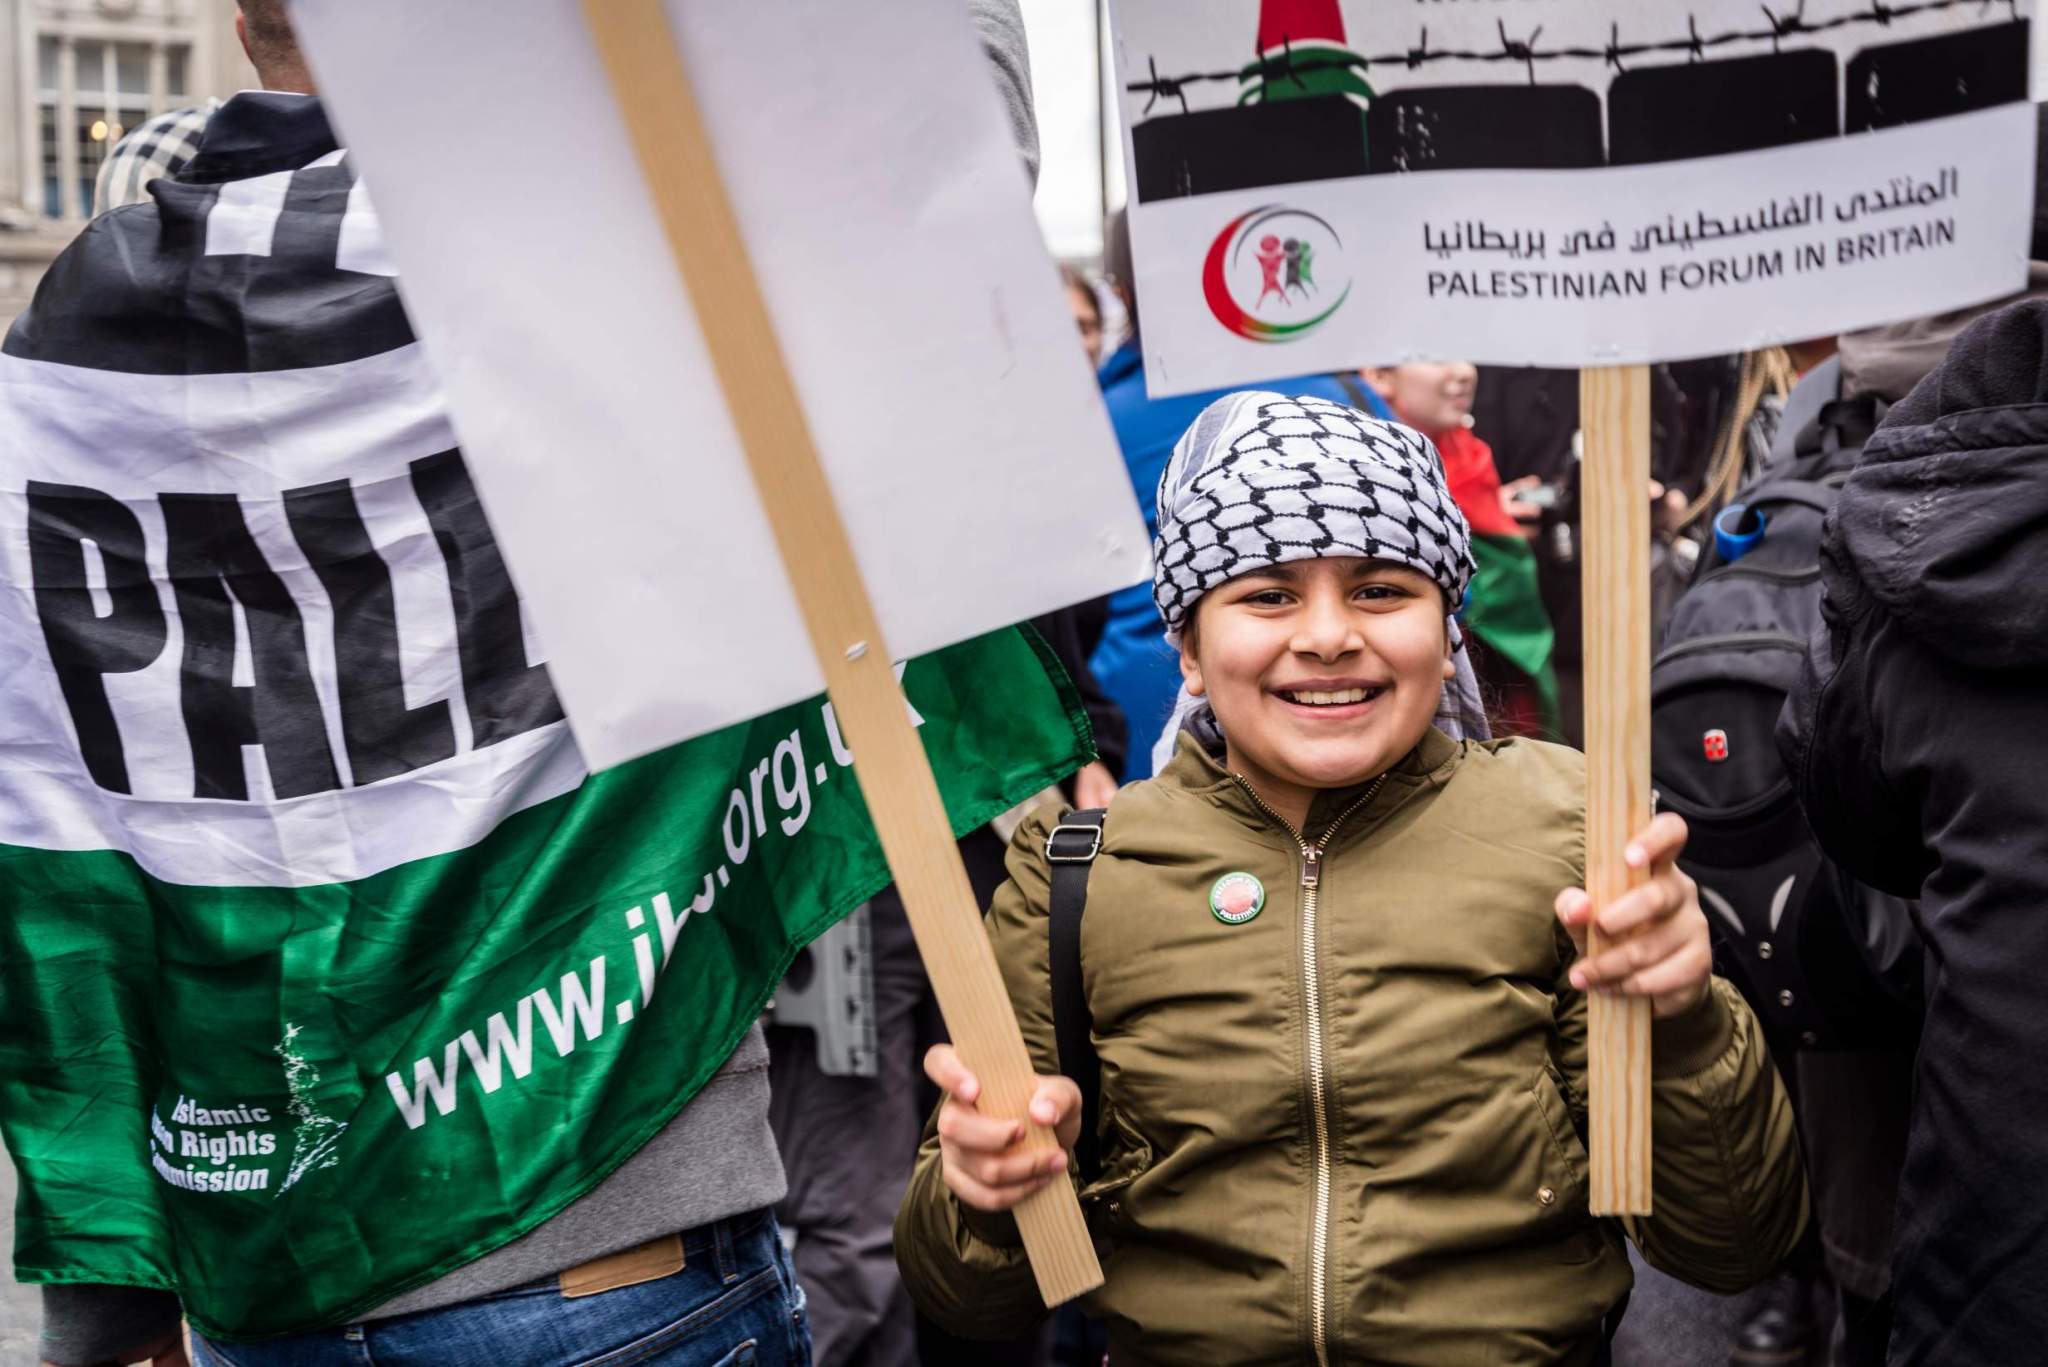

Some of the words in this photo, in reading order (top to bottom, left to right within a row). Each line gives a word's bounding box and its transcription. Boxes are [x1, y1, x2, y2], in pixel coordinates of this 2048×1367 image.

[1424, 221, 1546, 260] بريطانيا
[1428, 267, 1647, 299] PALESTINIAN
[1660, 251, 1783, 292] FORUM
[1795, 242, 1826, 272] IN
[1837, 217, 1955, 265] BRITAIN
[171, 1094, 271, 1126] Islamic
[180, 1129, 276, 1166] Rights
